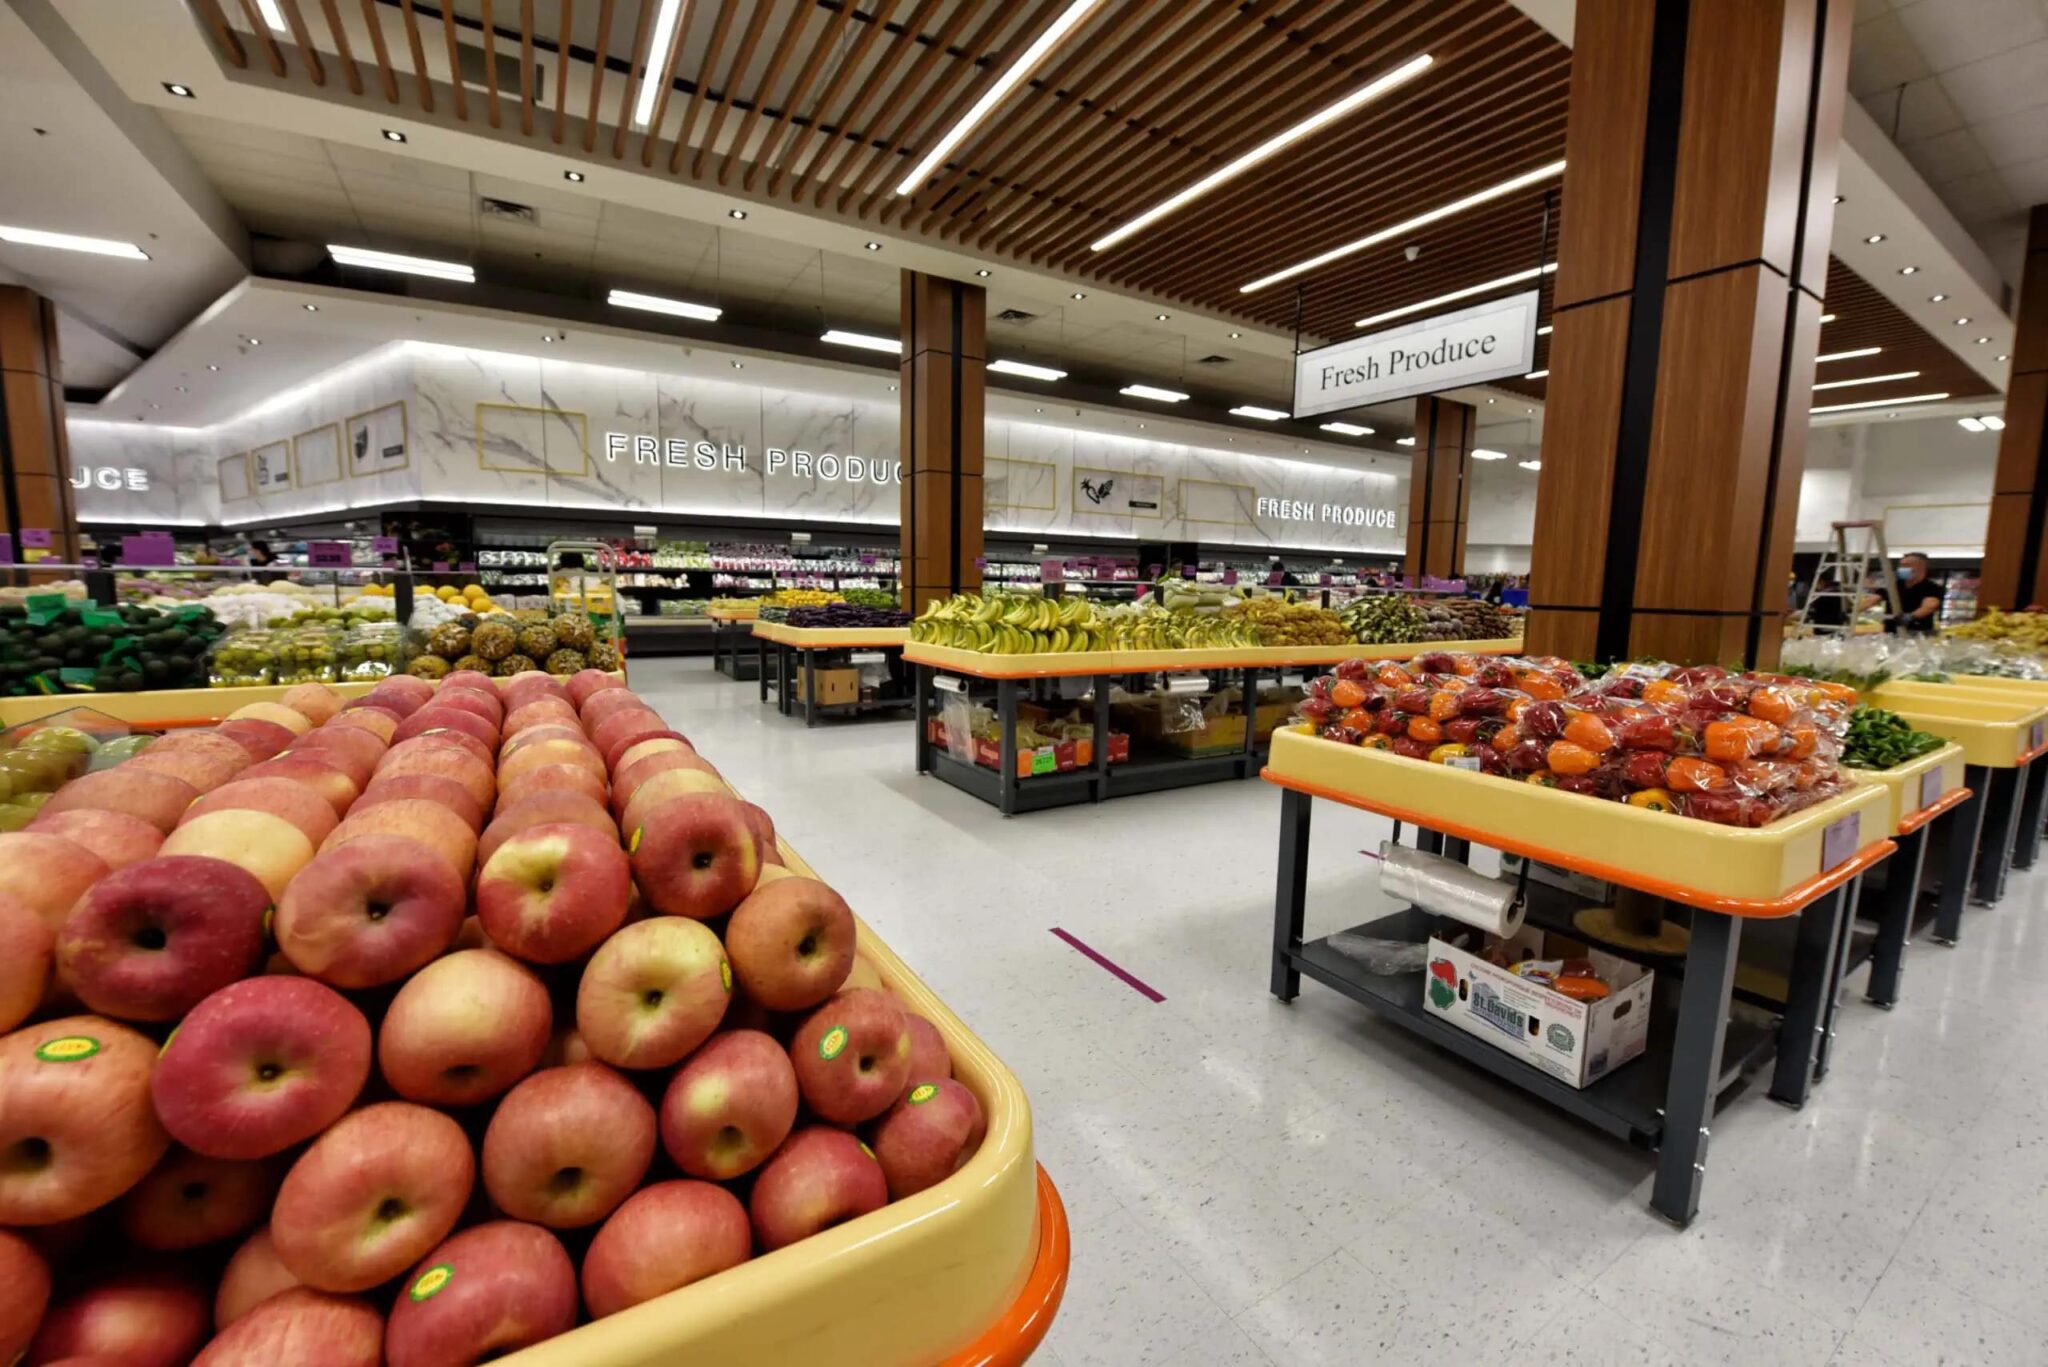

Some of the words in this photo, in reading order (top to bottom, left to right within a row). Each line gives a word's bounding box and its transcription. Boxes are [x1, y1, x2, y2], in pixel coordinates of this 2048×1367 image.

[1320, 356, 1380, 391] Fresh
[1388, 334, 1497, 376] Produce
[605, 431, 747, 472] FRESH
[1257, 497, 1315, 522] FRESH
[1321, 503, 1396, 529] PRODUCE
